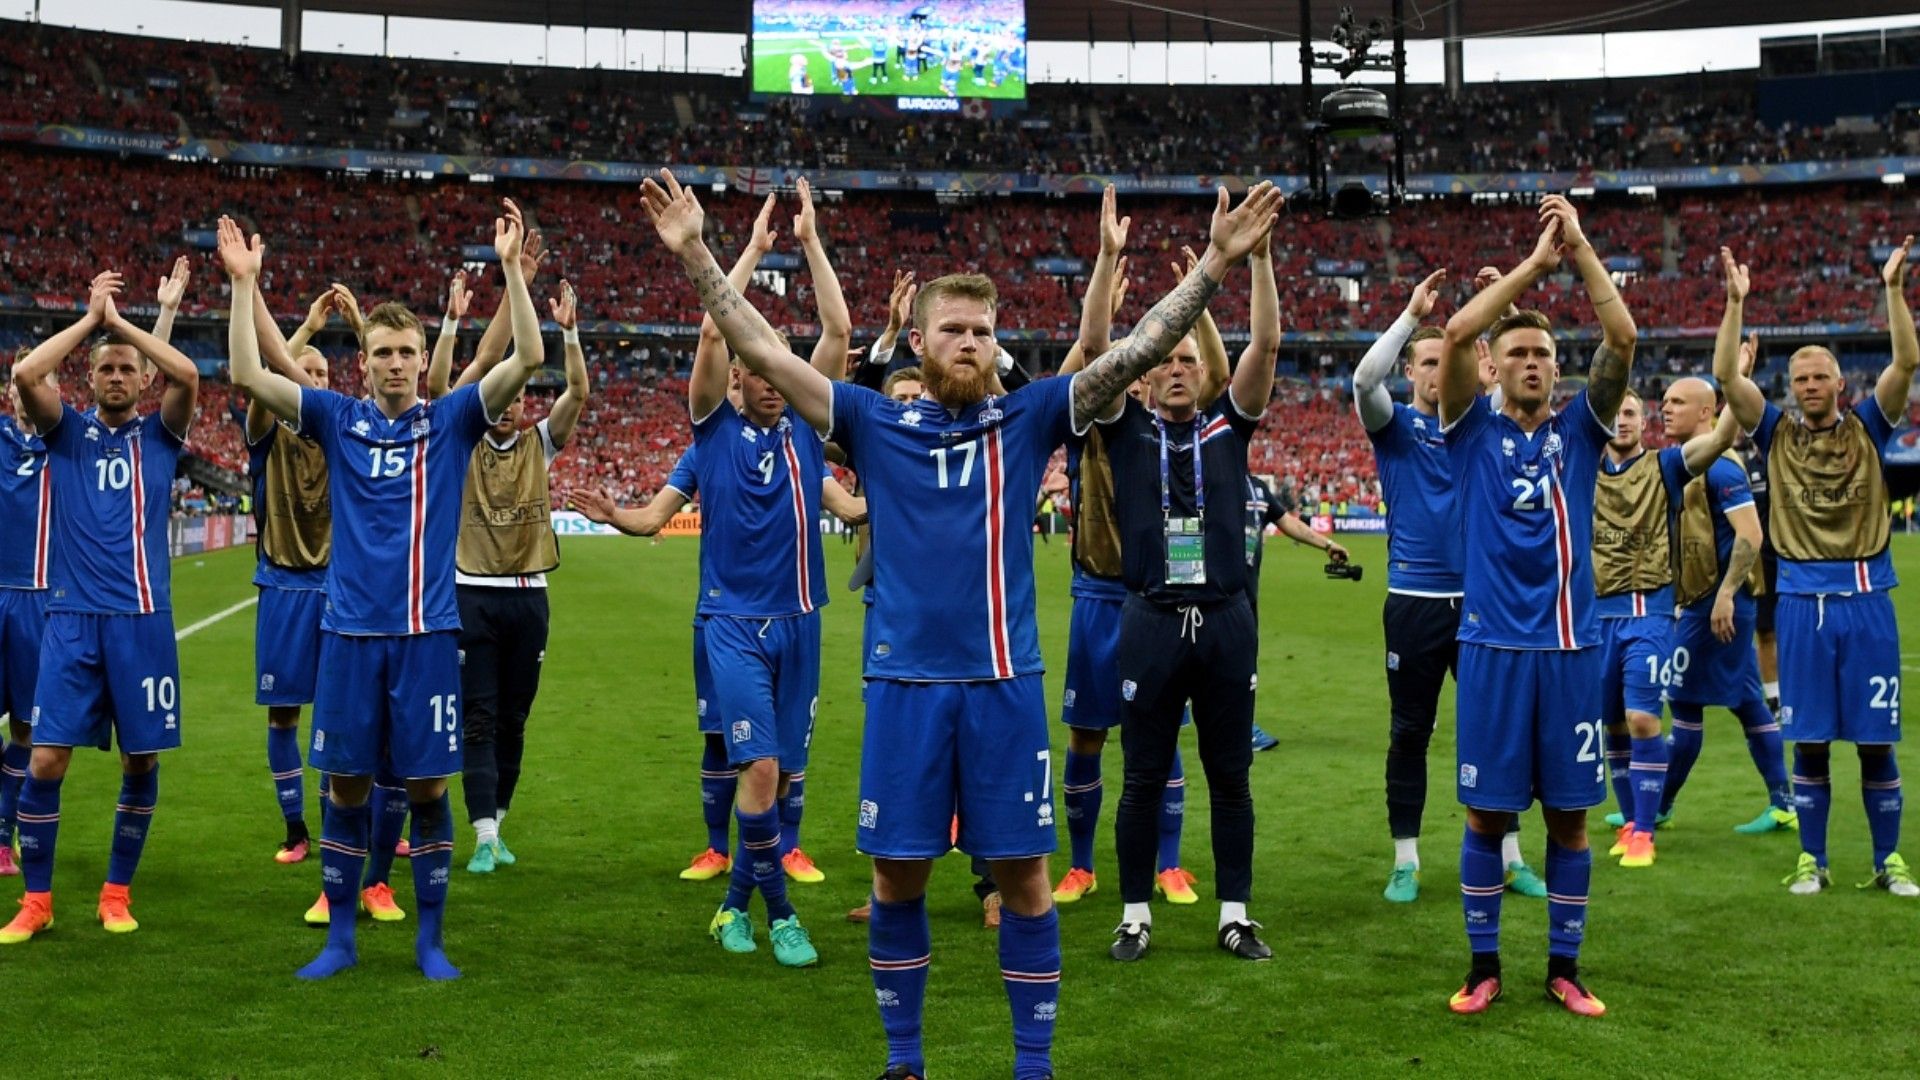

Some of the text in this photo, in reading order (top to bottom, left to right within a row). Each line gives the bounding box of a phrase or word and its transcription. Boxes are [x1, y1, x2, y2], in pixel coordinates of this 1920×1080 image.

[95, 457, 130, 491] 10
[369, 447, 406, 478] 15
[758, 451, 775, 485] 9
[929, 440, 977, 488] 17
[1512, 475, 1551, 510] 21
[1333, 518, 1386, 530] TURKISH
[1646, 655, 1672, 687] 16
[141, 676, 176, 712] 10
[1869, 675, 1899, 709] 22
[430, 694, 457, 733] 15
[1574, 718, 1604, 763] 21
